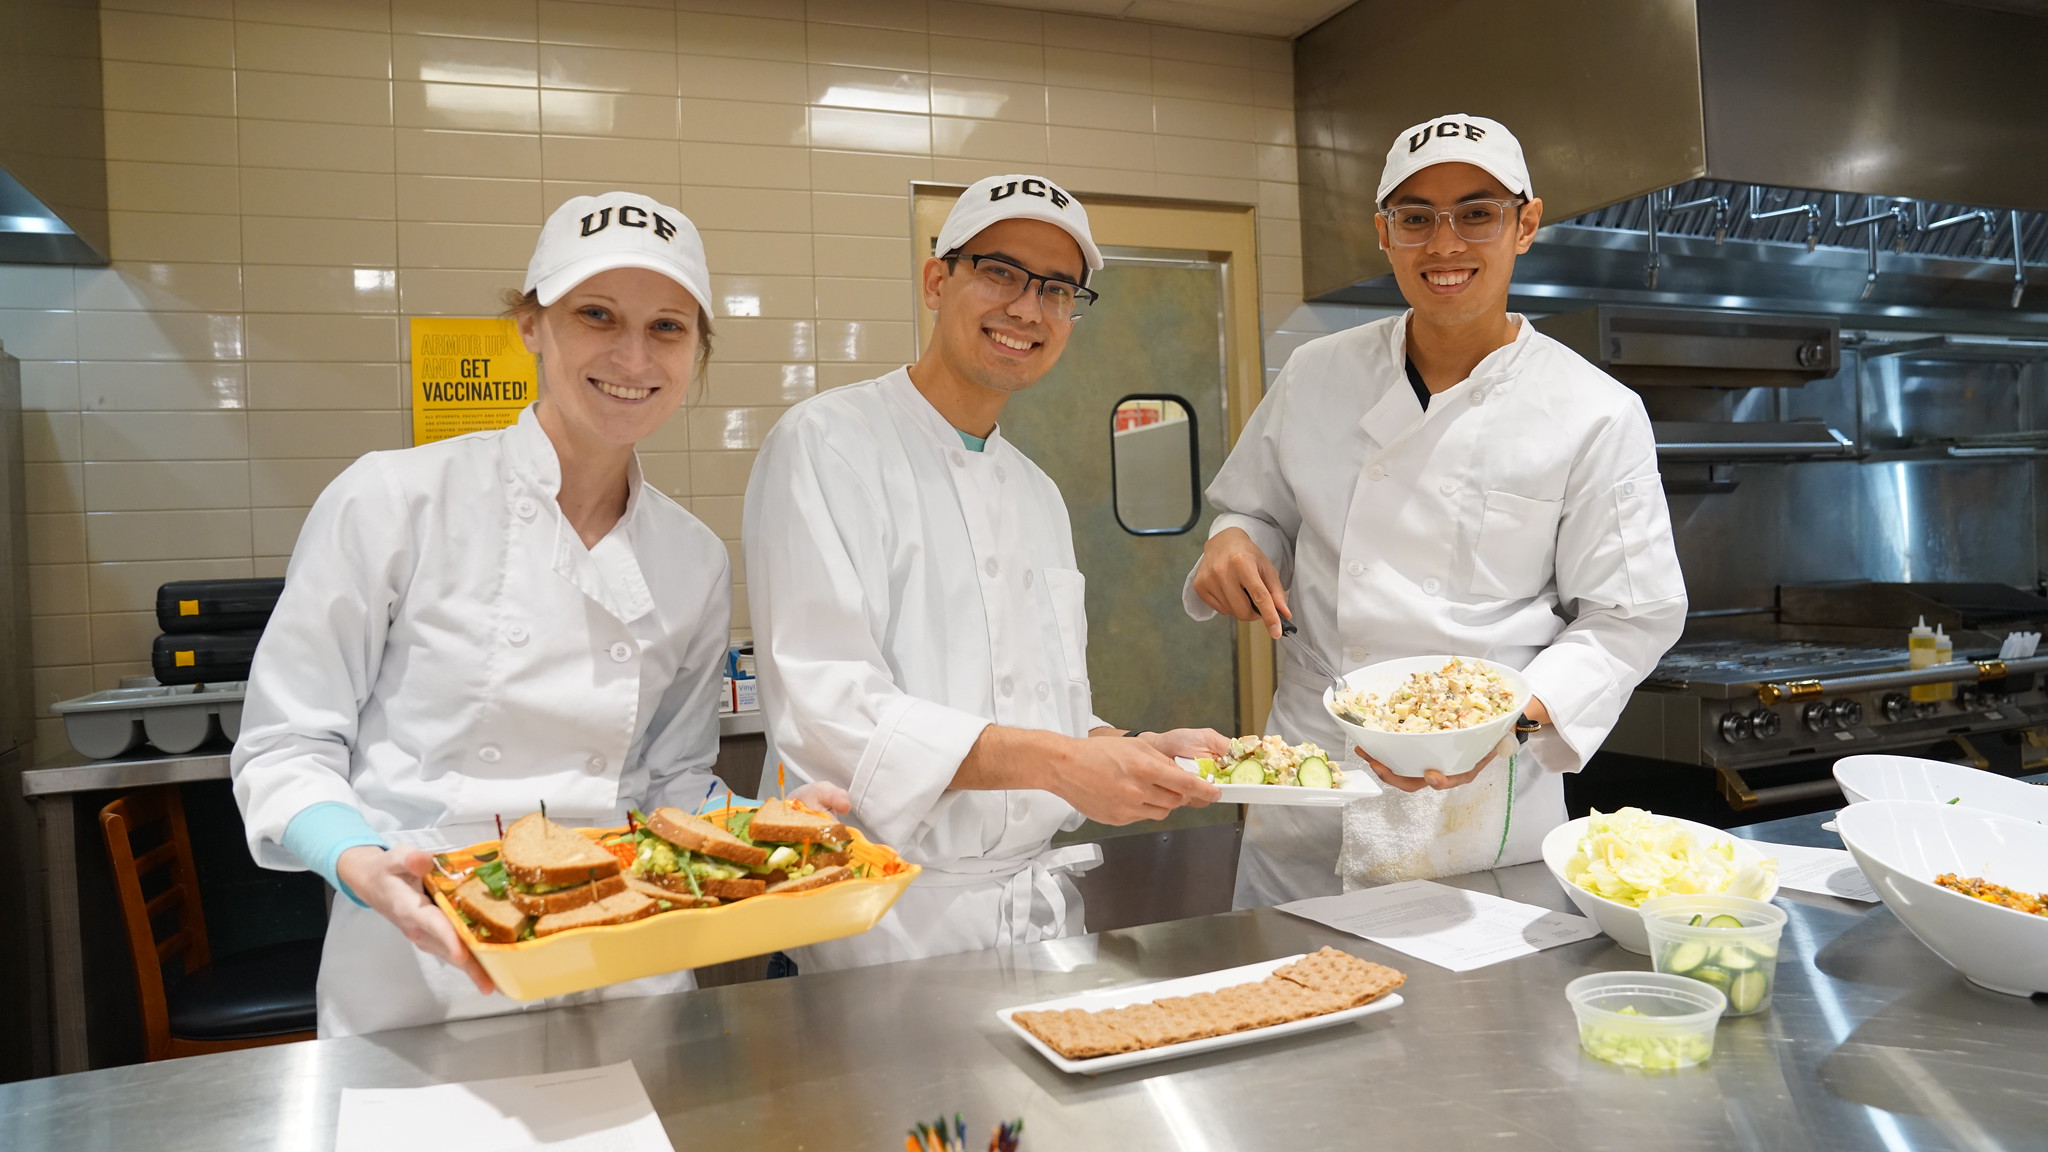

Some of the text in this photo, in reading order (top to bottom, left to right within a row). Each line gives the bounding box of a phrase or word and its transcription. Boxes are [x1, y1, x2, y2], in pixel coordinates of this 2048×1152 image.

[1408, 121, 1486, 153] UCF
[988, 178, 1070, 209] UCF
[580, 205, 678, 242] UCF
[421, 334, 508, 356] ARMOR UP
[421, 357, 491, 379] AND GET
[422, 381, 528, 402] VACCINATED!
